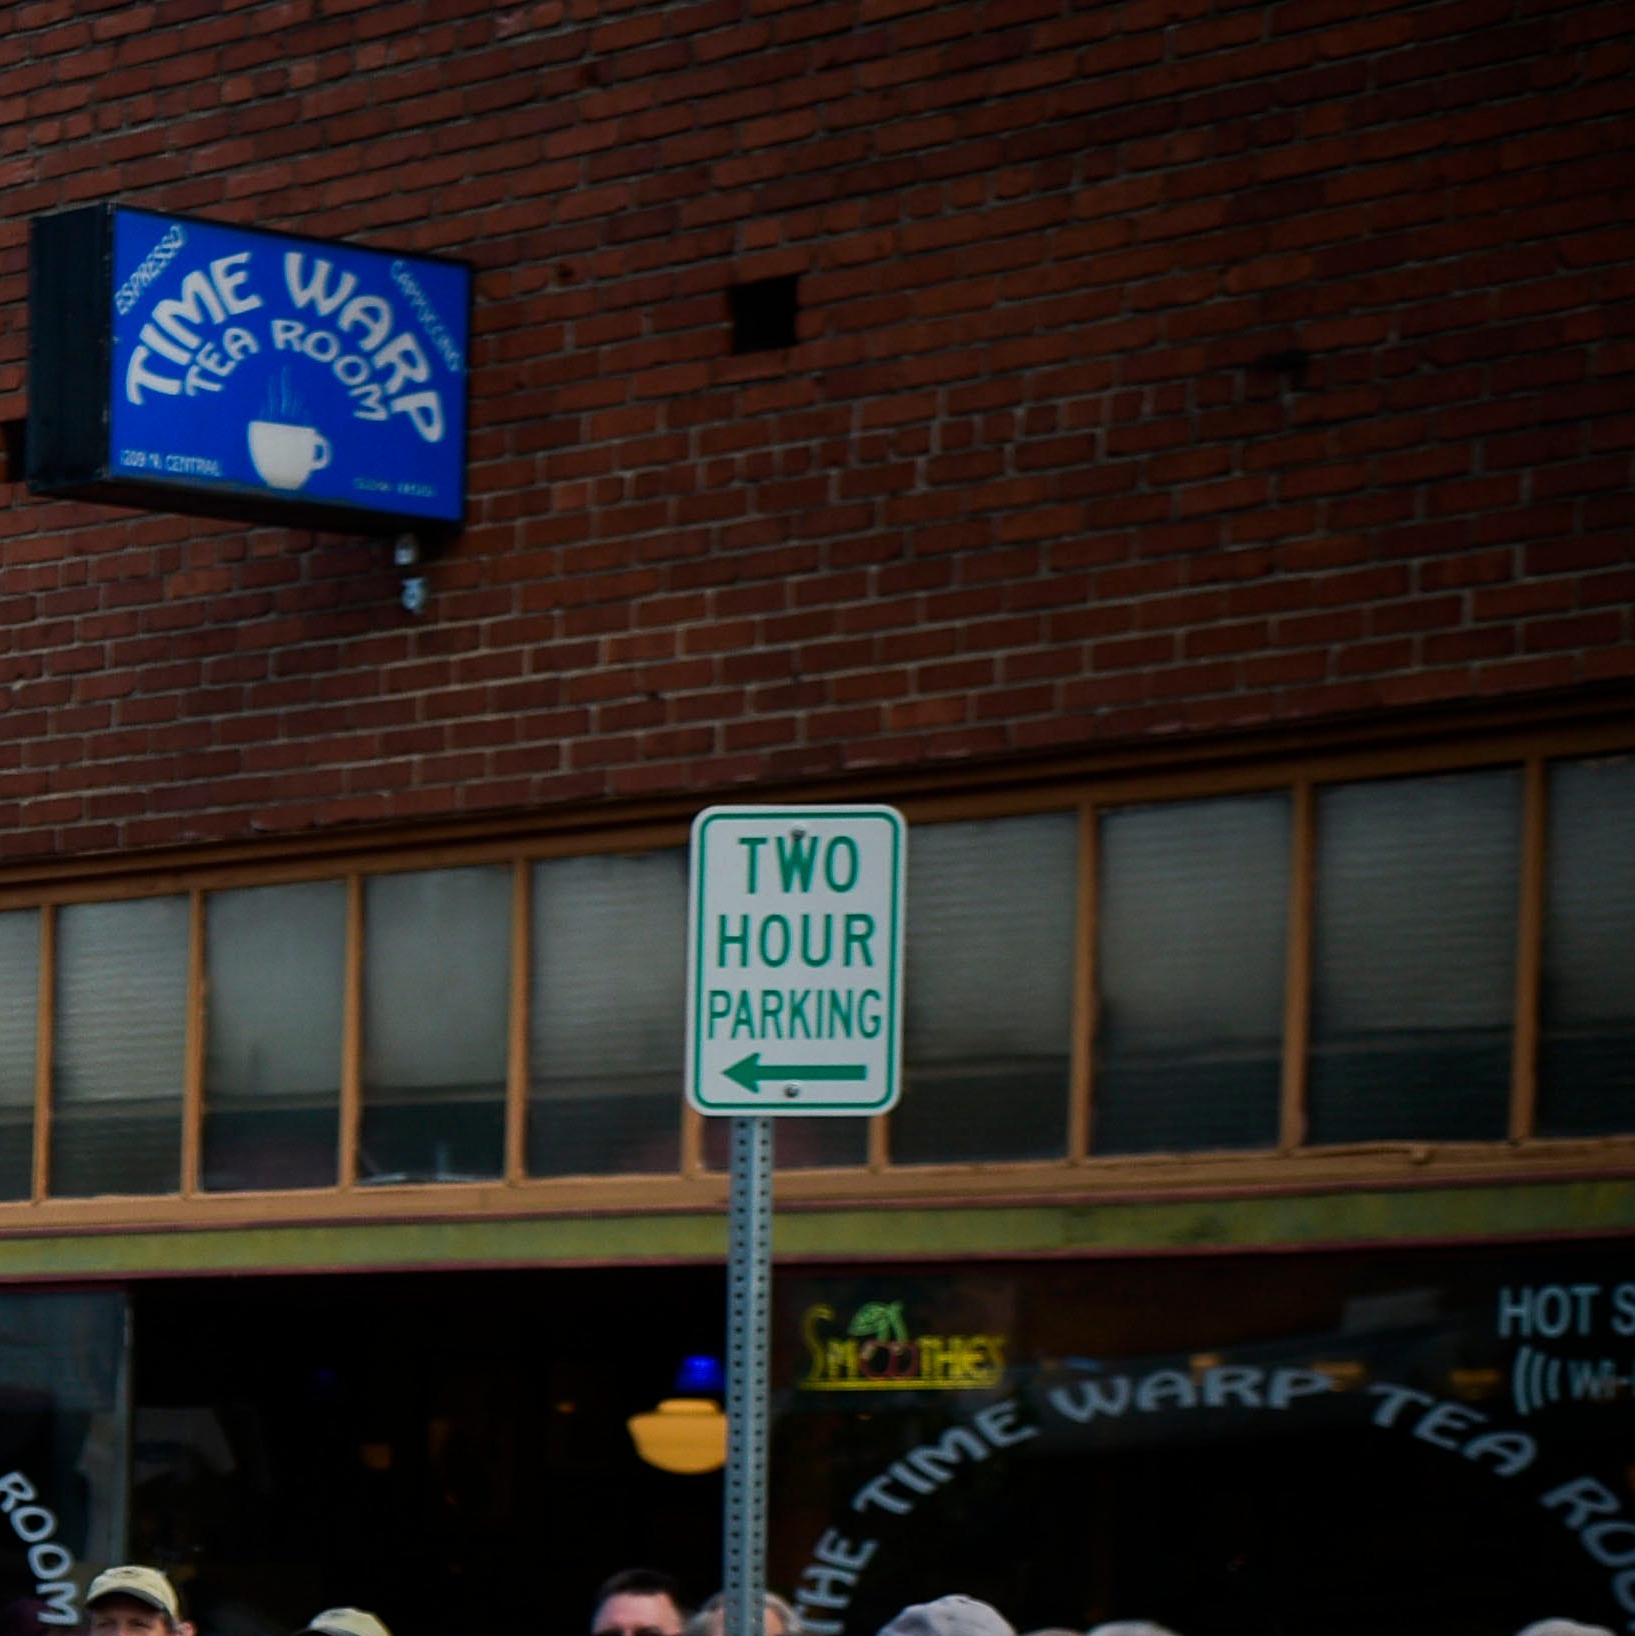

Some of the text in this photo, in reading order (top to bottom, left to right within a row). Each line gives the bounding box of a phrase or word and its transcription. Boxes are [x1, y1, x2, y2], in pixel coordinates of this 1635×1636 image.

[127, 252, 445, 443] TIME WARP
[186, 319, 389, 421] TEA ROOM
[738, 836, 860, 894] TWO
[717, 914, 876, 968] HOUR
[707, 989, 882, 1039] PARKING
[1498, 1285, 1601, 1336] HOT
[853, 1402, 1039, 1515] TIME
[1051, 1366, 1332, 1424] WARP
[1366, 1382, 1538, 1477] TEA
